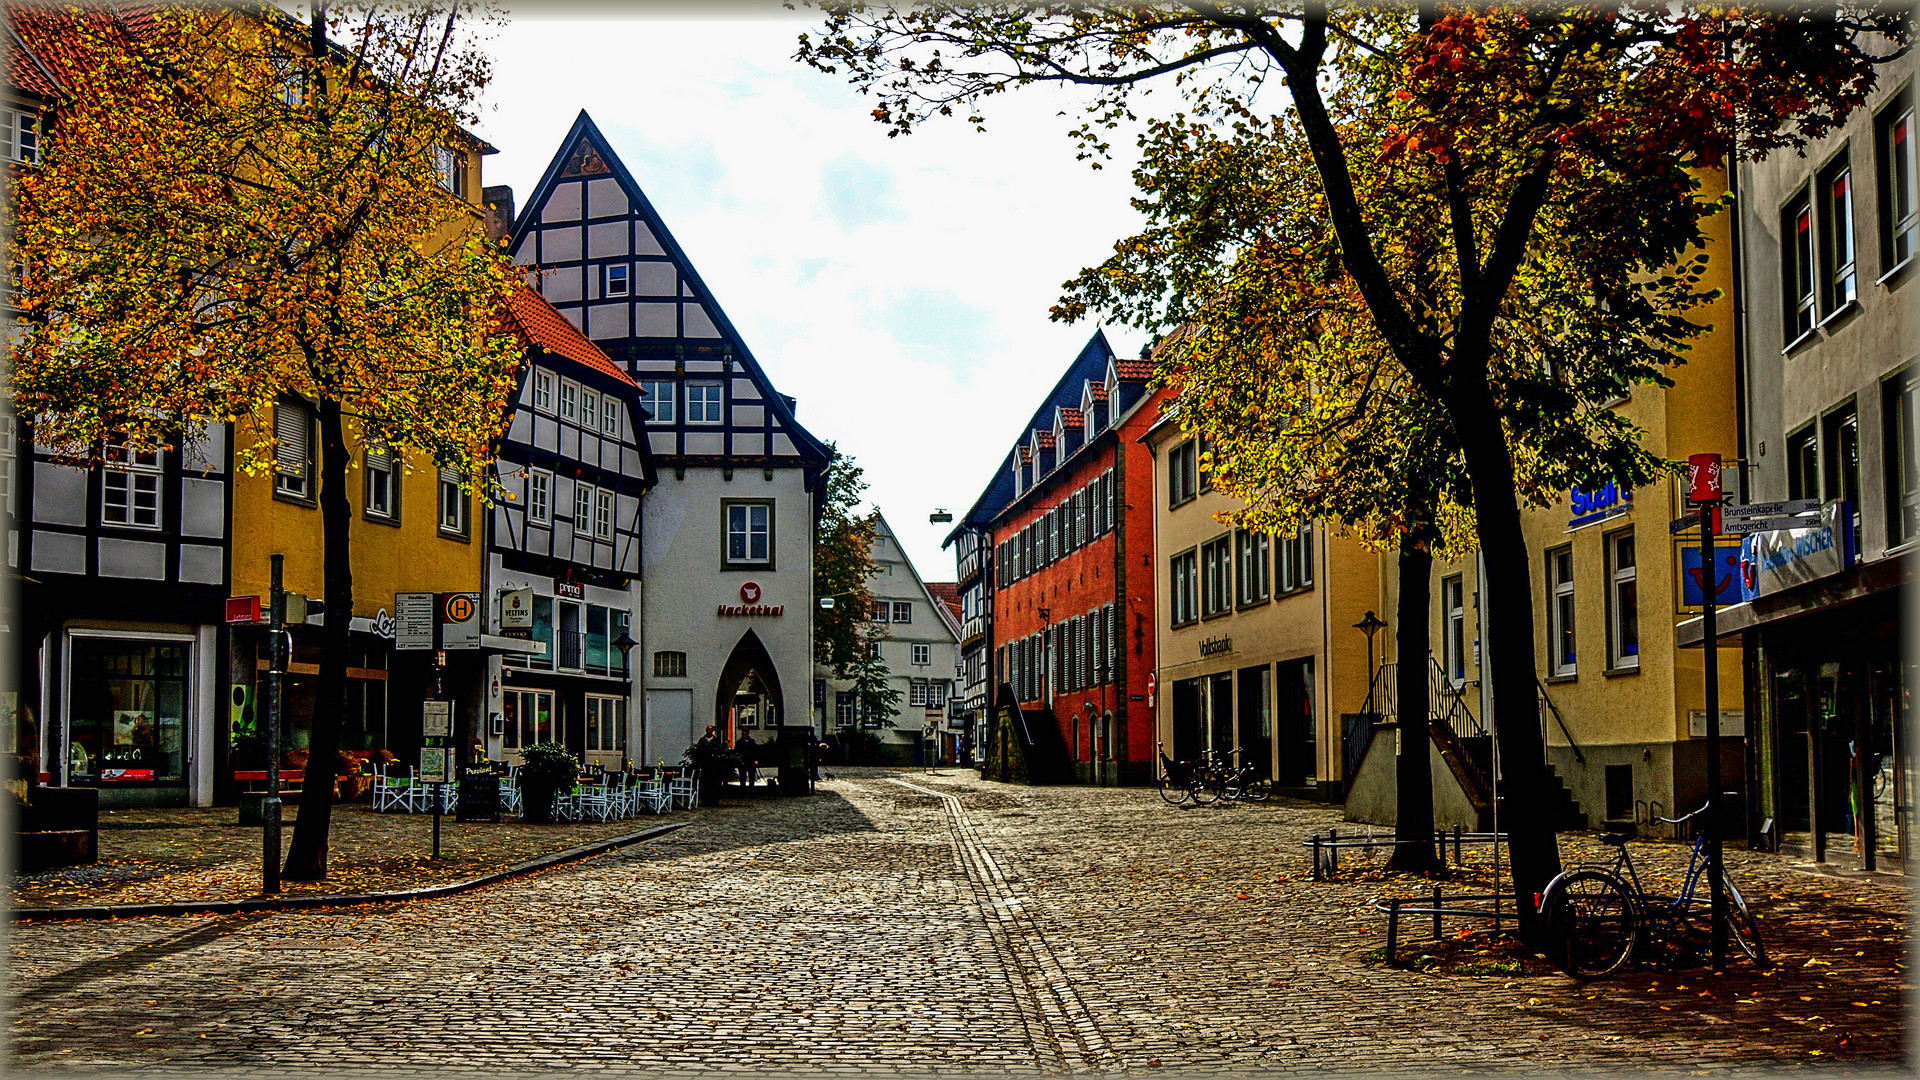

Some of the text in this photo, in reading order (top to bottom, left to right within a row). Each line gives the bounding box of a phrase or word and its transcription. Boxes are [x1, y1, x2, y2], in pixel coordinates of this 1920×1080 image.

[1724, 518, 1820, 533] Amtsgericht 250m
[505, 609, 528, 617] VELTINS
[717, 604, 784, 617] Hackethal
[1198, 633, 1232, 657] Volksbank
